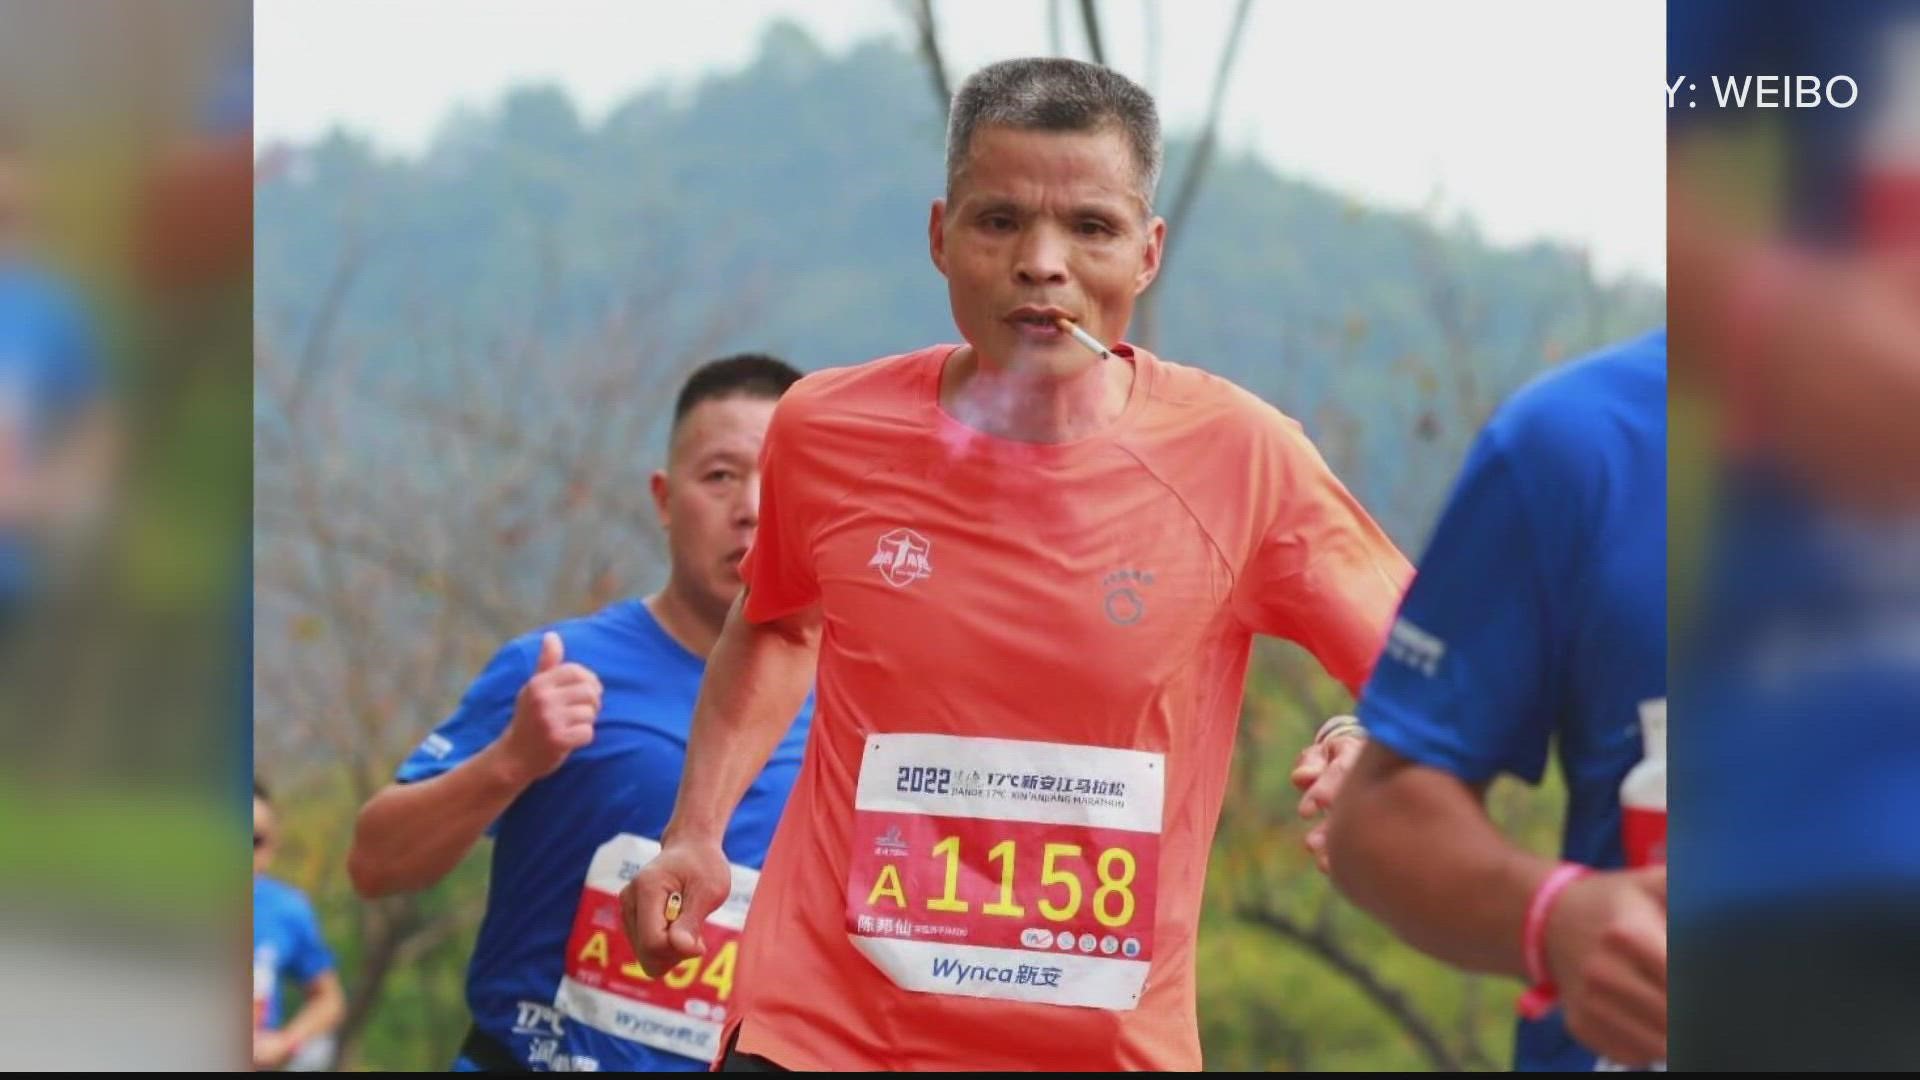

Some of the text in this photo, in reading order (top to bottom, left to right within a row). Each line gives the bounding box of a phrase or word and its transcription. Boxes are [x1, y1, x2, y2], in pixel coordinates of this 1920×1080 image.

[897, 766, 951, 794] 2022
[867, 836, 1136, 927] A 1158
[578, 931, 609, 967] A
[932, 958, 1014, 985] Wynca
